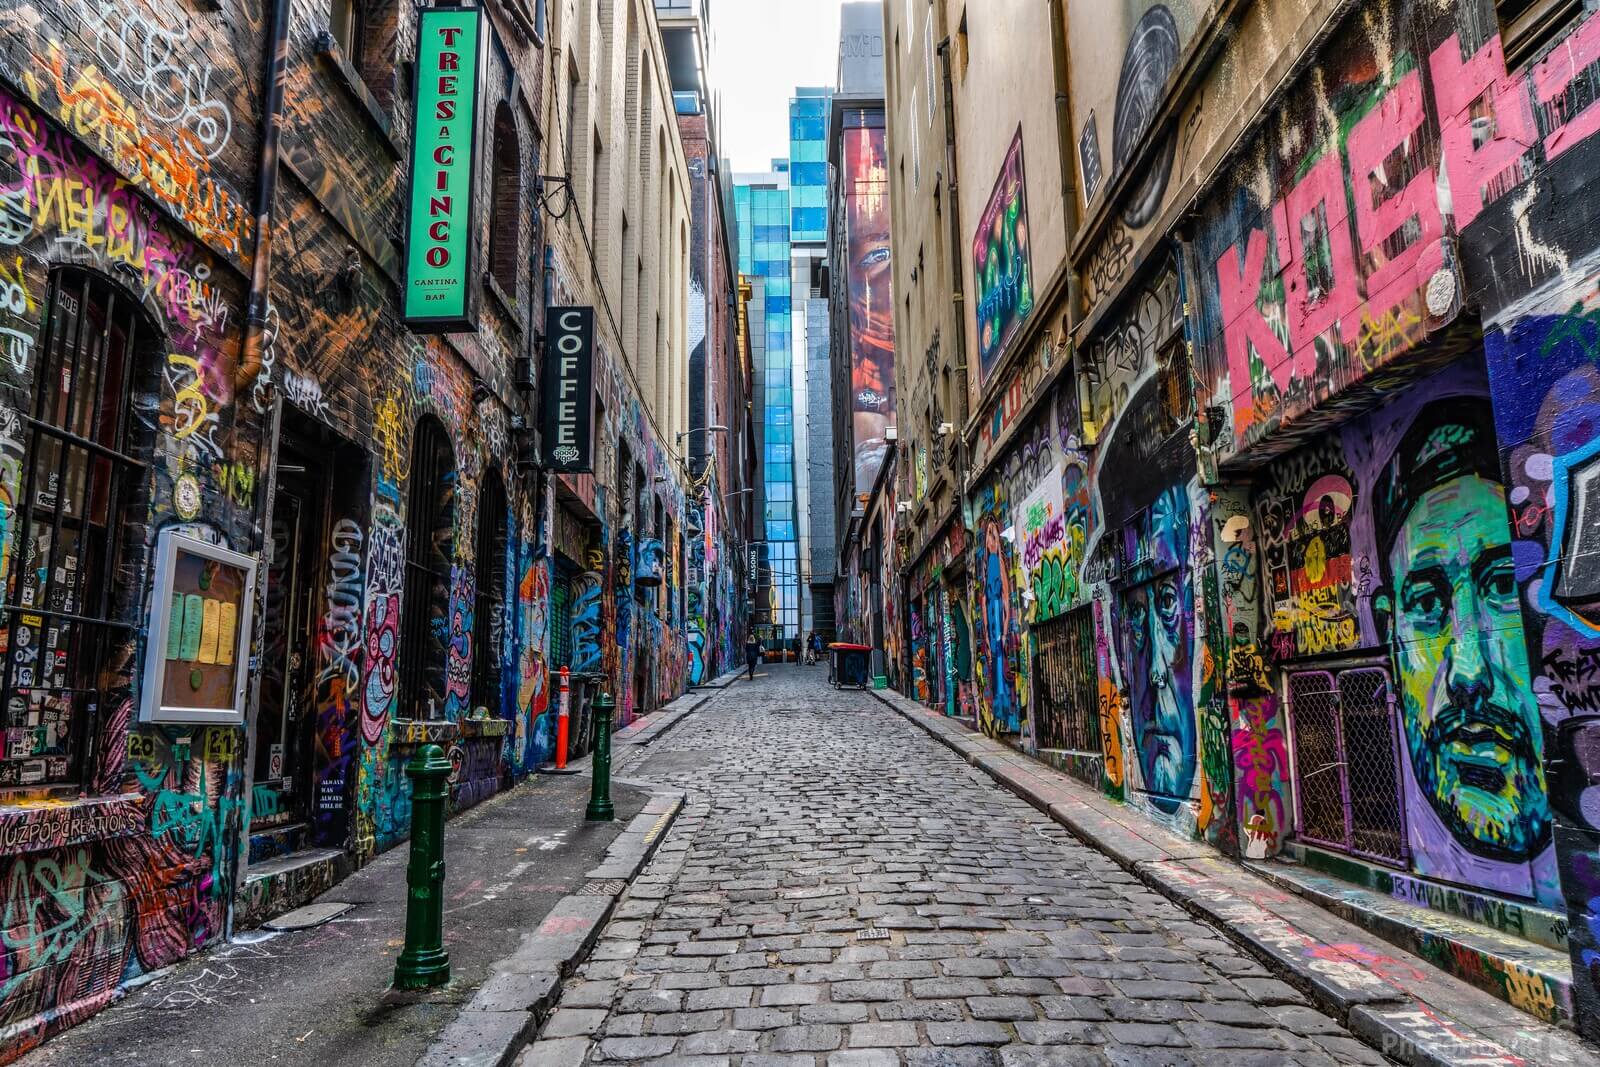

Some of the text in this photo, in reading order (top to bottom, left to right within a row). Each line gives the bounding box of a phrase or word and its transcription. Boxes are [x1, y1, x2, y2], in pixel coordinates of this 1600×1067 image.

[438, 125, 450, 139] A
[425, 145, 454, 269] CINCO
[414, 278, 458, 286] CANTINA
[425, 293, 446, 301] BAR
[557, 311, 583, 444] COFFEE
[129, 735, 154, 756] 20
